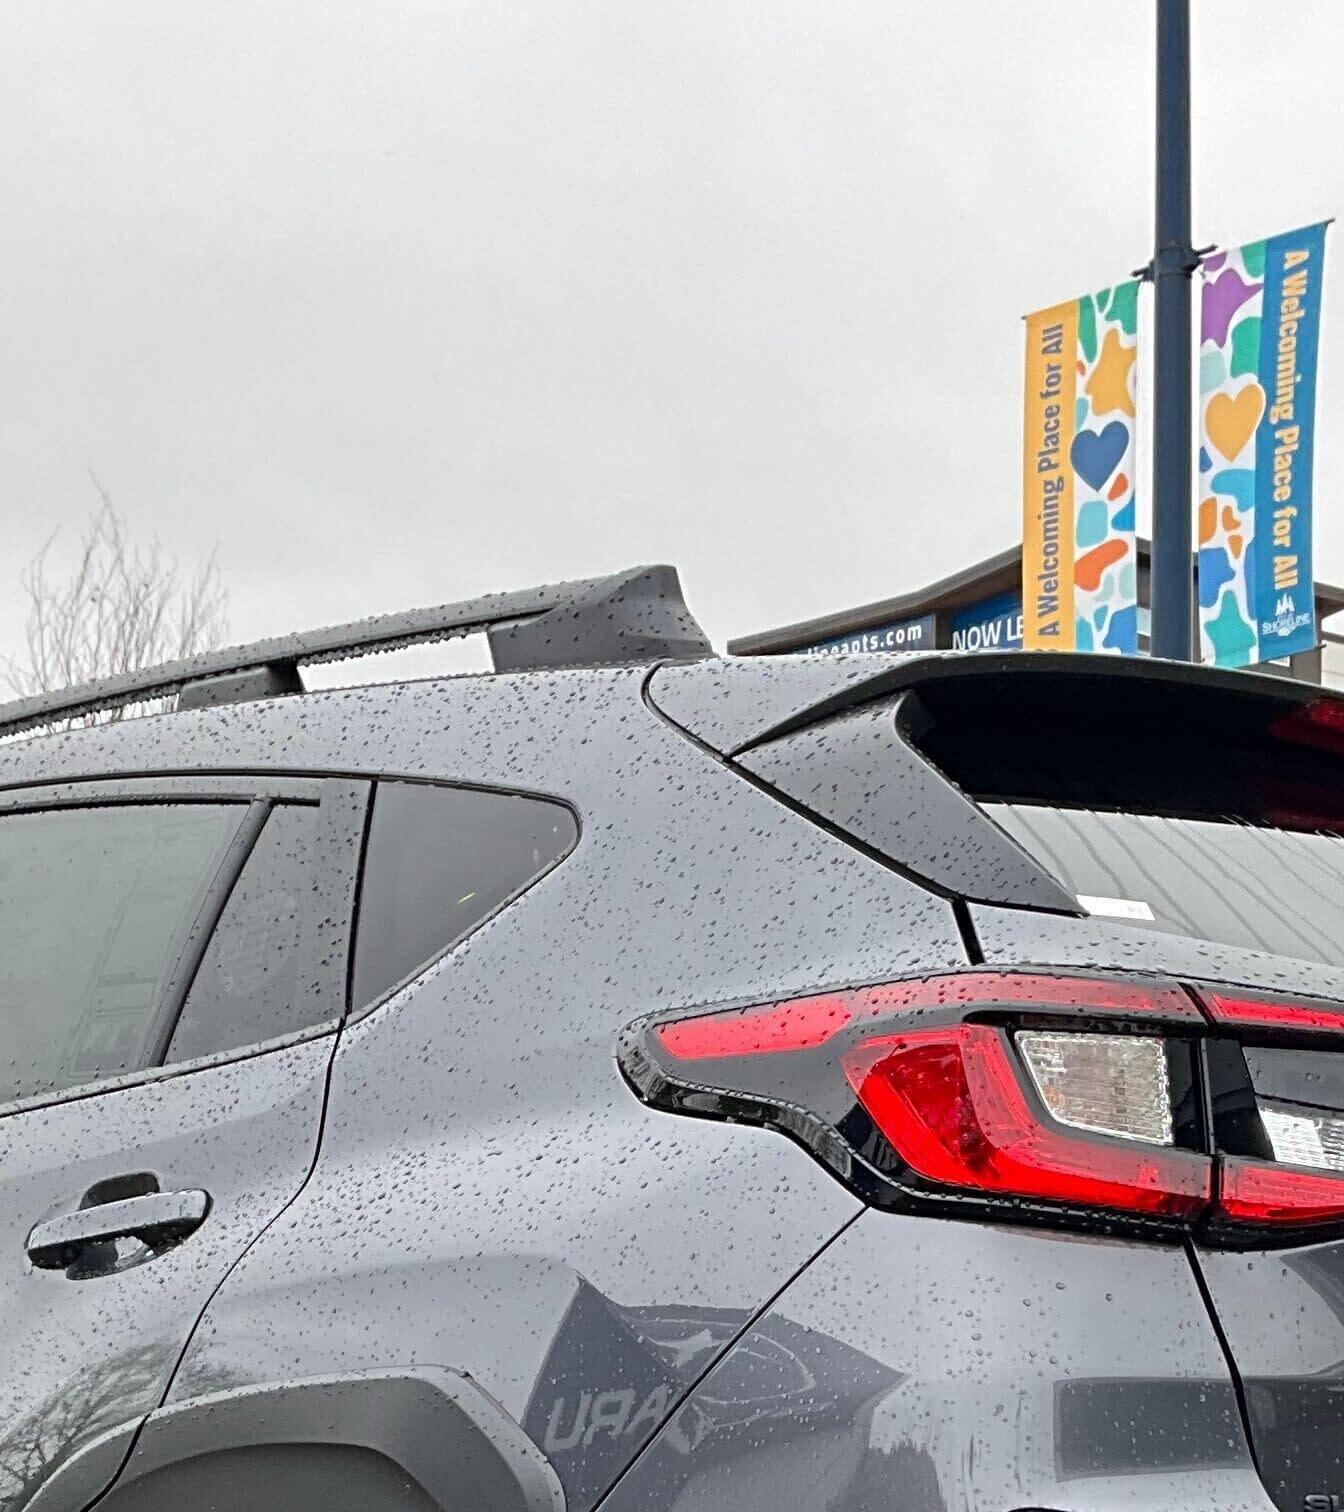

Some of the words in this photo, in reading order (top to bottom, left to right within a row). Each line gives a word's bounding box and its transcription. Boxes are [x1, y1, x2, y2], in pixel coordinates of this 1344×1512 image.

[1284, 251, 1309, 270] A
[1041, 323, 1064, 356] All
[1269, 270, 1308, 425] Welcoming
[1040, 363, 1062, 400] for
[1038, 403, 1061, 473] Place
[1273, 425, 1300, 502] Place
[1273, 506, 1298, 547] for
[1037, 476, 1064, 618] Welcoming
[1273, 554, 1298, 590] All
[952, 620, 1002, 651] NOW
[1038, 620, 1060, 636] A
